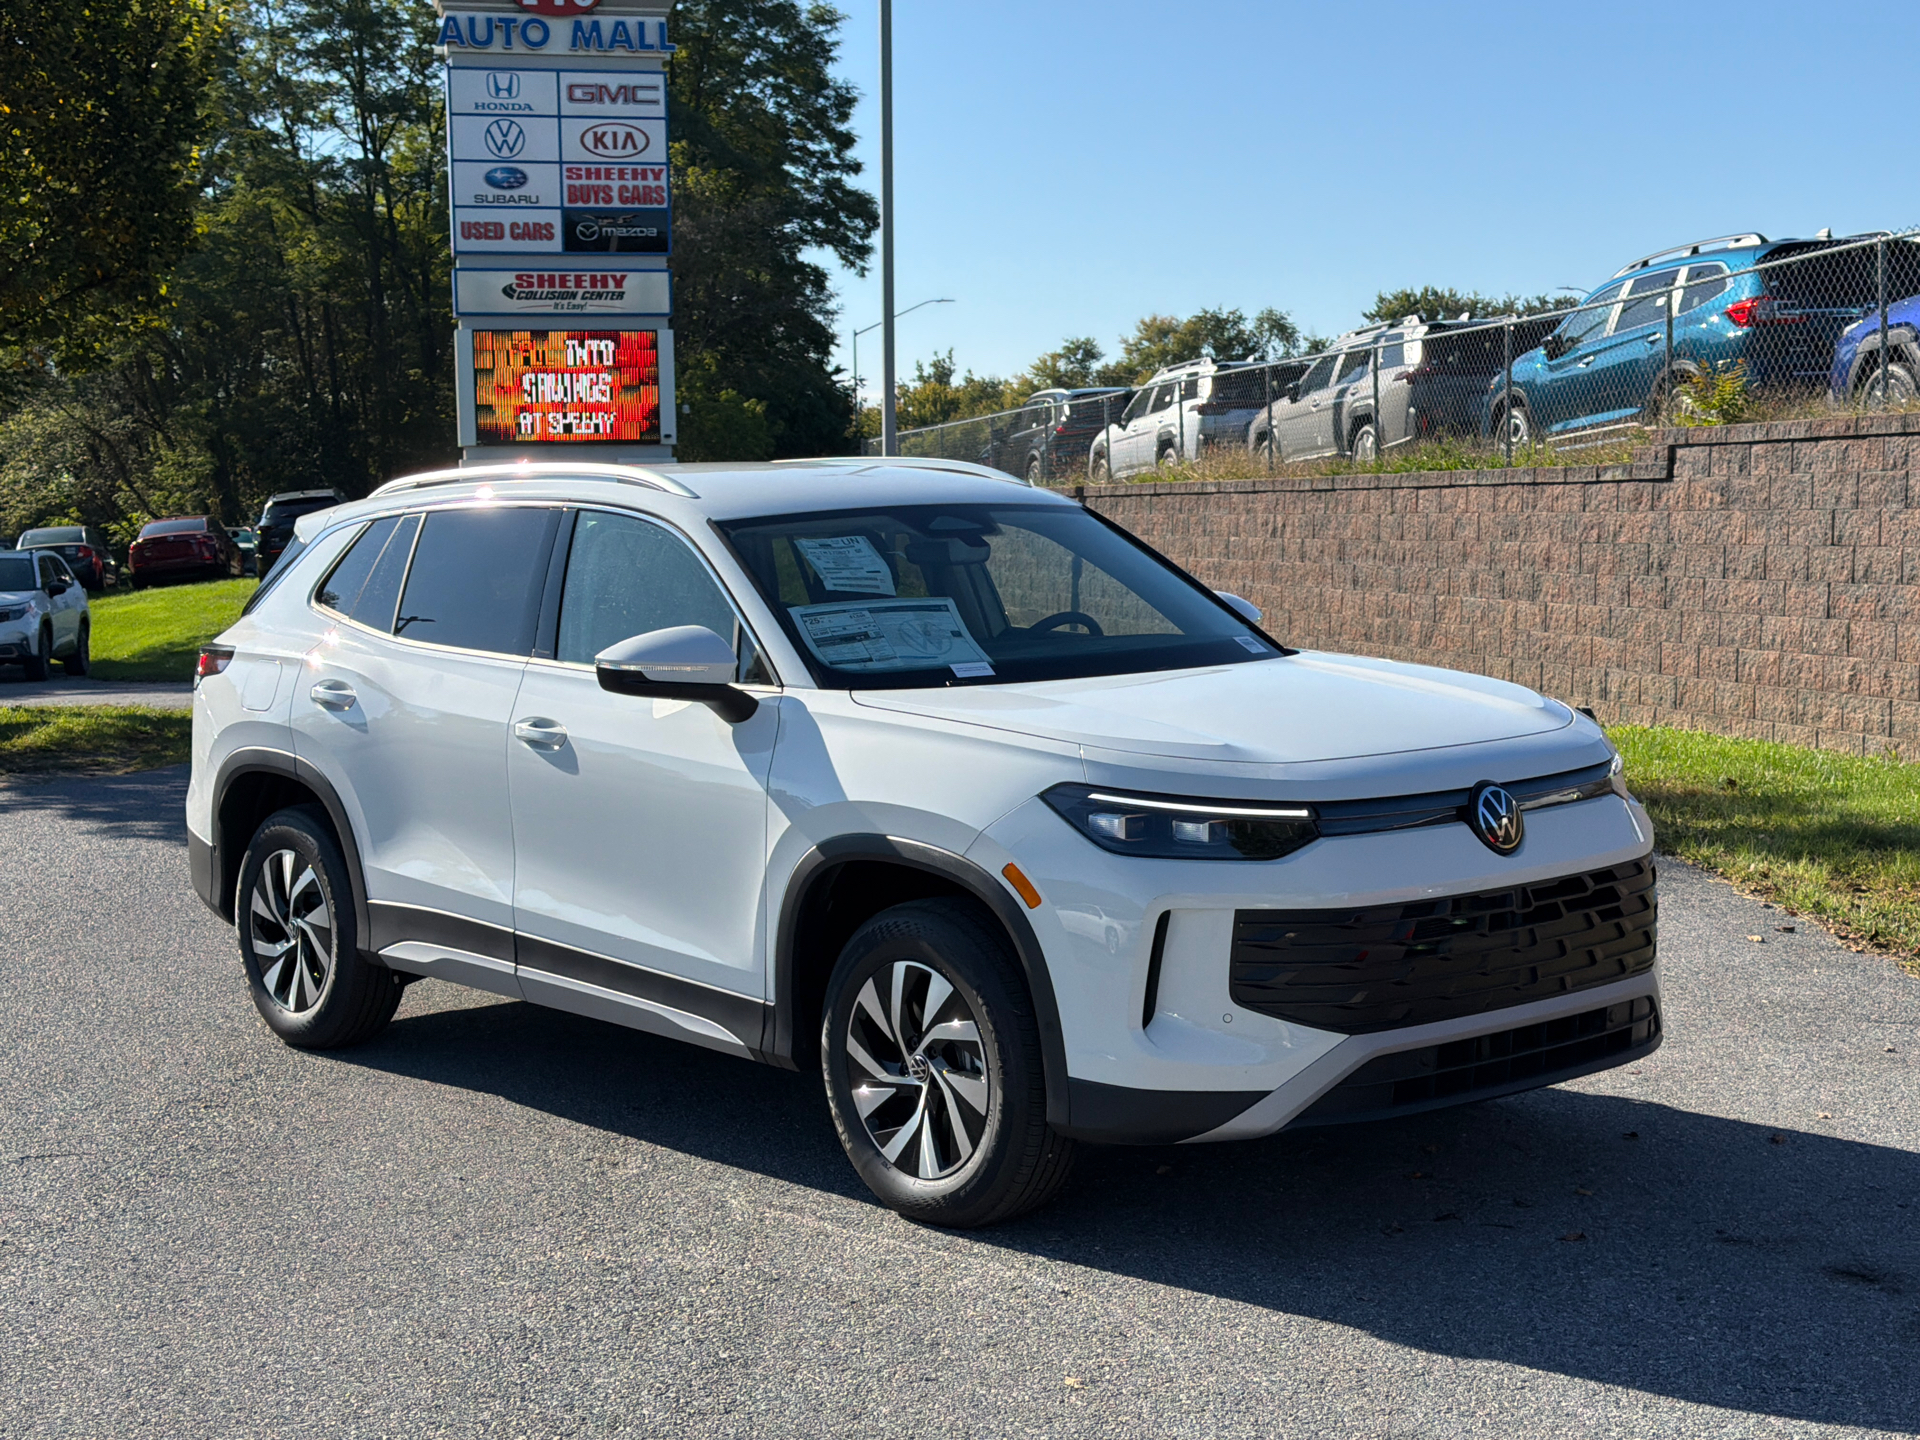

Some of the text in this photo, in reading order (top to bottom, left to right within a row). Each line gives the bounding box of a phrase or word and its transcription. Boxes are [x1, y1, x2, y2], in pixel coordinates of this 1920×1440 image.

[437, 16, 677, 52] AUTO MALL
[567, 83, 660, 106] GMC
[474, 101, 534, 112] HONDA
[592, 130, 639, 151] KIA
[565, 166, 666, 182] SHEEHY
[473, 194, 540, 205] SUBARU
[566, 184, 666, 206] BUYS CARS
[460, 220, 555, 241] USED CARS
[601, 226, 658, 238] mazda
[514, 273, 628, 290] SHEEHY
[516, 290, 627, 301] COLLISION CENTER
[553, 301, 588, 312] It's Easy!
[565, 339, 616, 366] INTO
[522, 372, 612, 403] SAVINGS
[519, 411, 544, 434] AT
